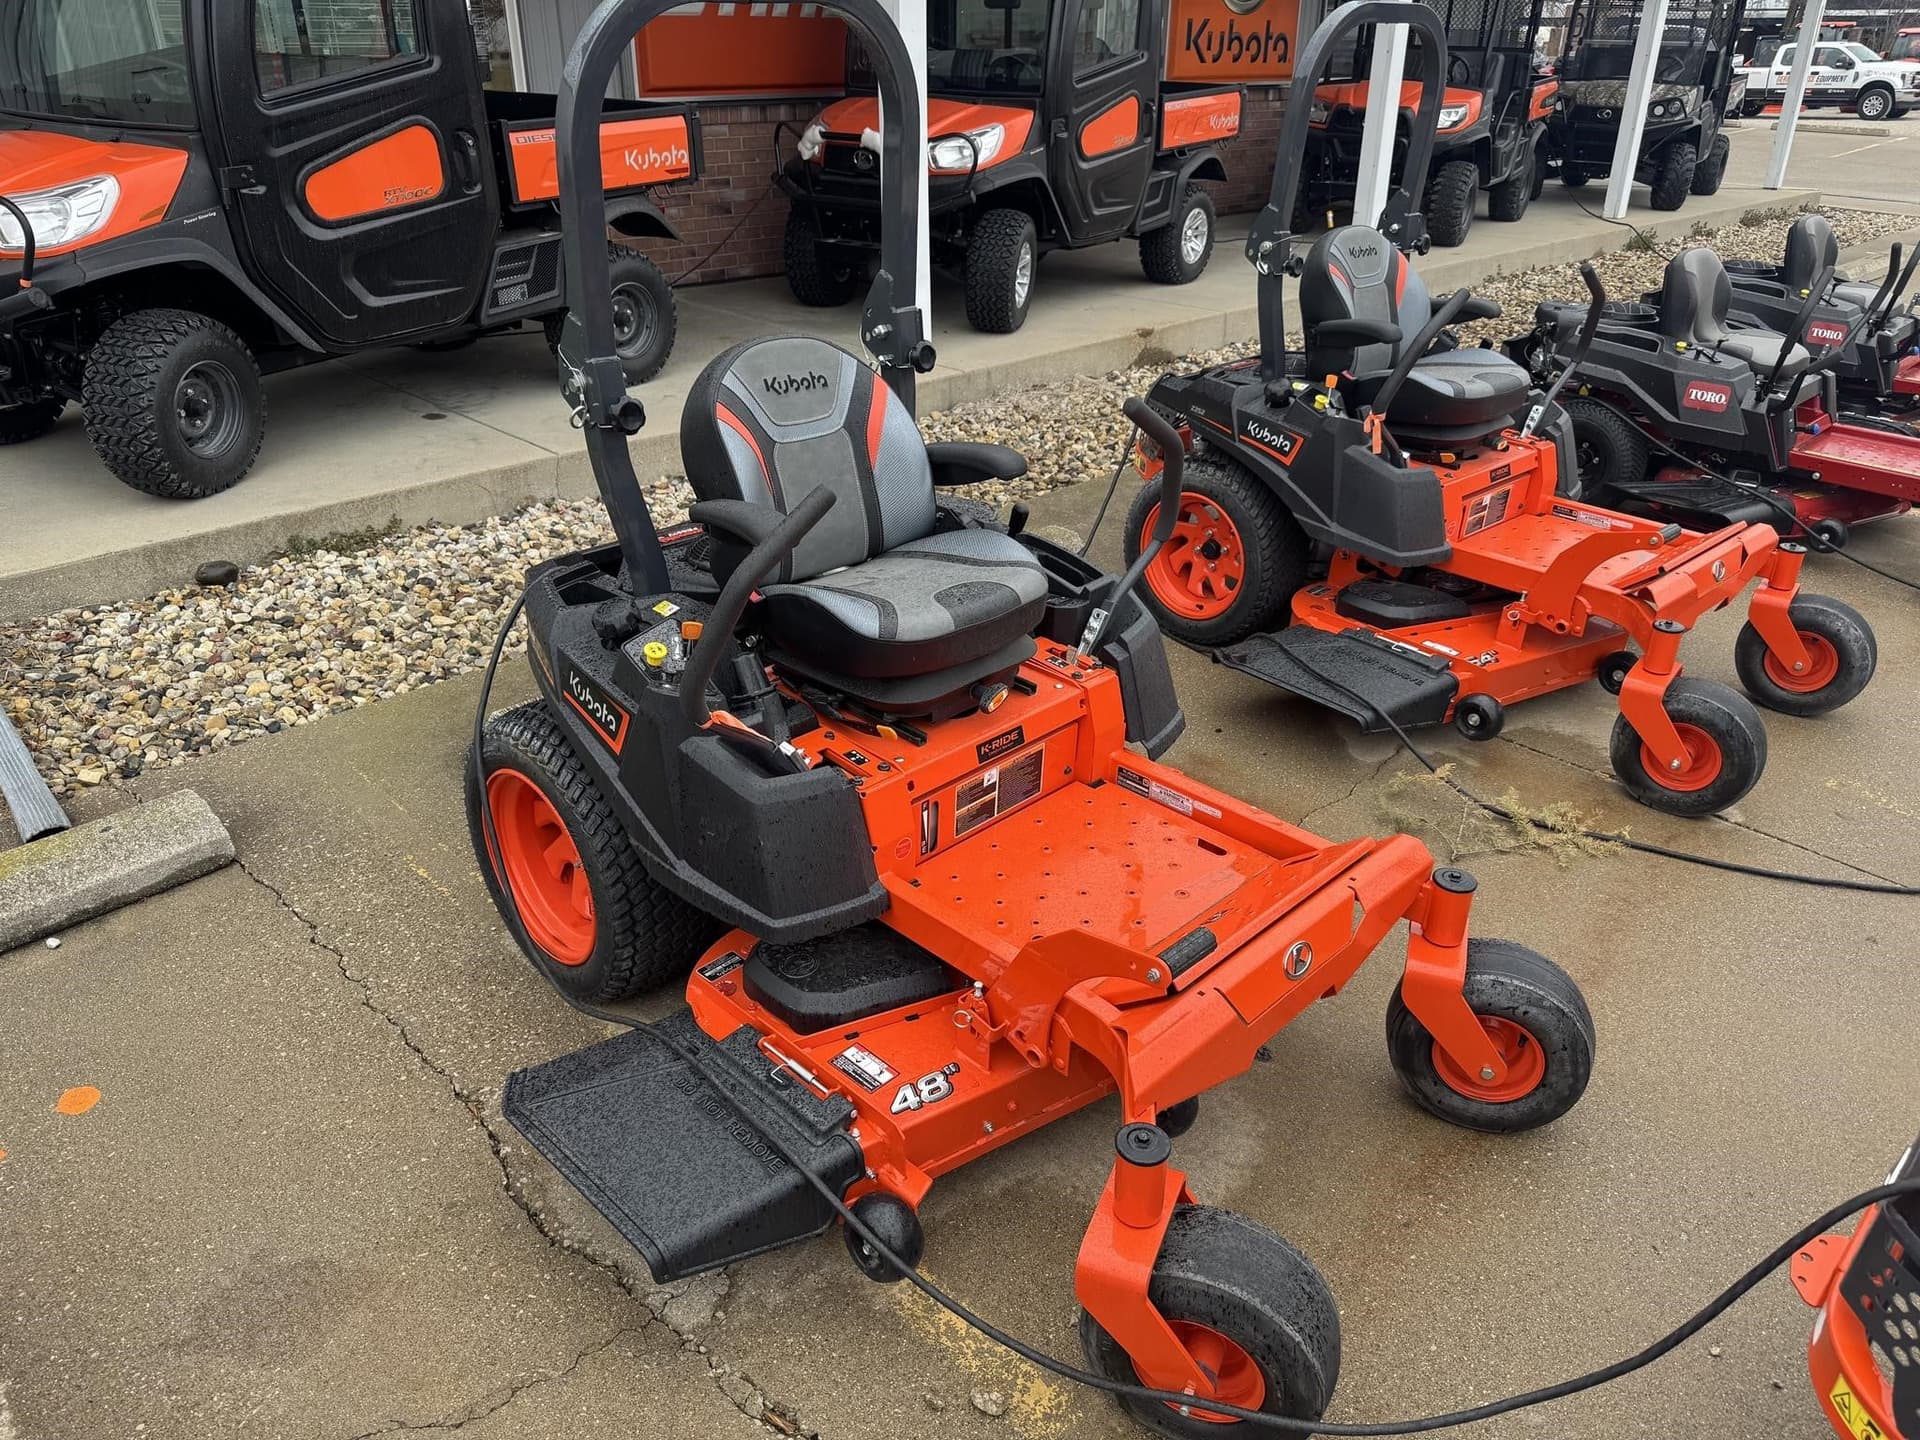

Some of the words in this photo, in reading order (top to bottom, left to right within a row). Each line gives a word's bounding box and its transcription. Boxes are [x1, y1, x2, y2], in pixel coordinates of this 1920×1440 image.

[1185, 18, 1289, 64] Kubota
[1210, 113, 1239, 129] Kubota
[624, 144, 689, 170] Kubota
[1349, 244, 1378, 259] Kubota
[1811, 327, 1843, 340] TORO
[763, 370, 828, 395] Kubota
[1688, 388, 1727, 404] TORO
[1247, 420, 1291, 453] Kubota
[569, 670, 616, 732] Kubota
[981, 730, 1020, 755] K-RIDE
[673, 1076, 698, 1096] DO
[698, 1097, 728, 1121] NOT
[725, 1117, 787, 1176] REMOVE
